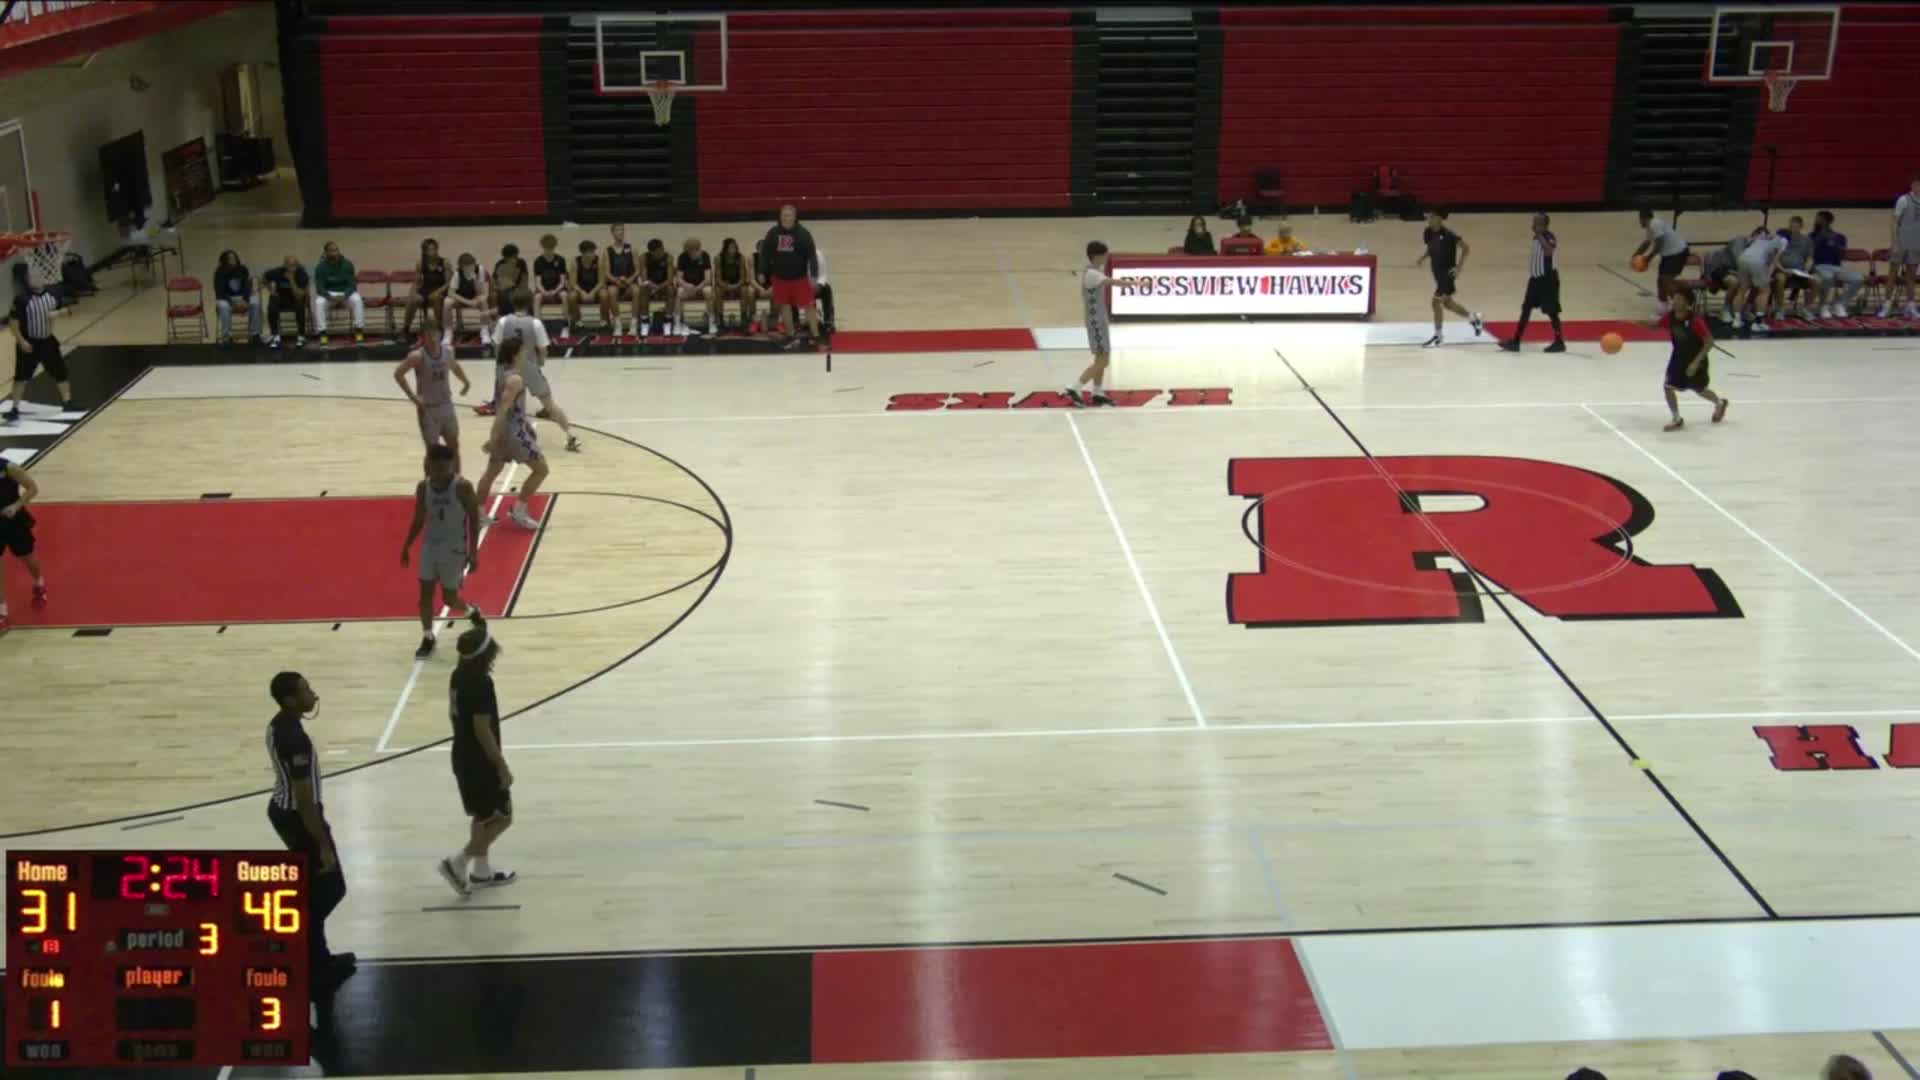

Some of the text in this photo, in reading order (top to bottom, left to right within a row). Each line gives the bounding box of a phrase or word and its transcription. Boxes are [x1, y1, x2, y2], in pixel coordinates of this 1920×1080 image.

[1120, 274, 1363, 297] ROSSVIEW HAWKS
[885, 387, 1233, 411] HAWKS
[1226, 455, 1744, 629] R
